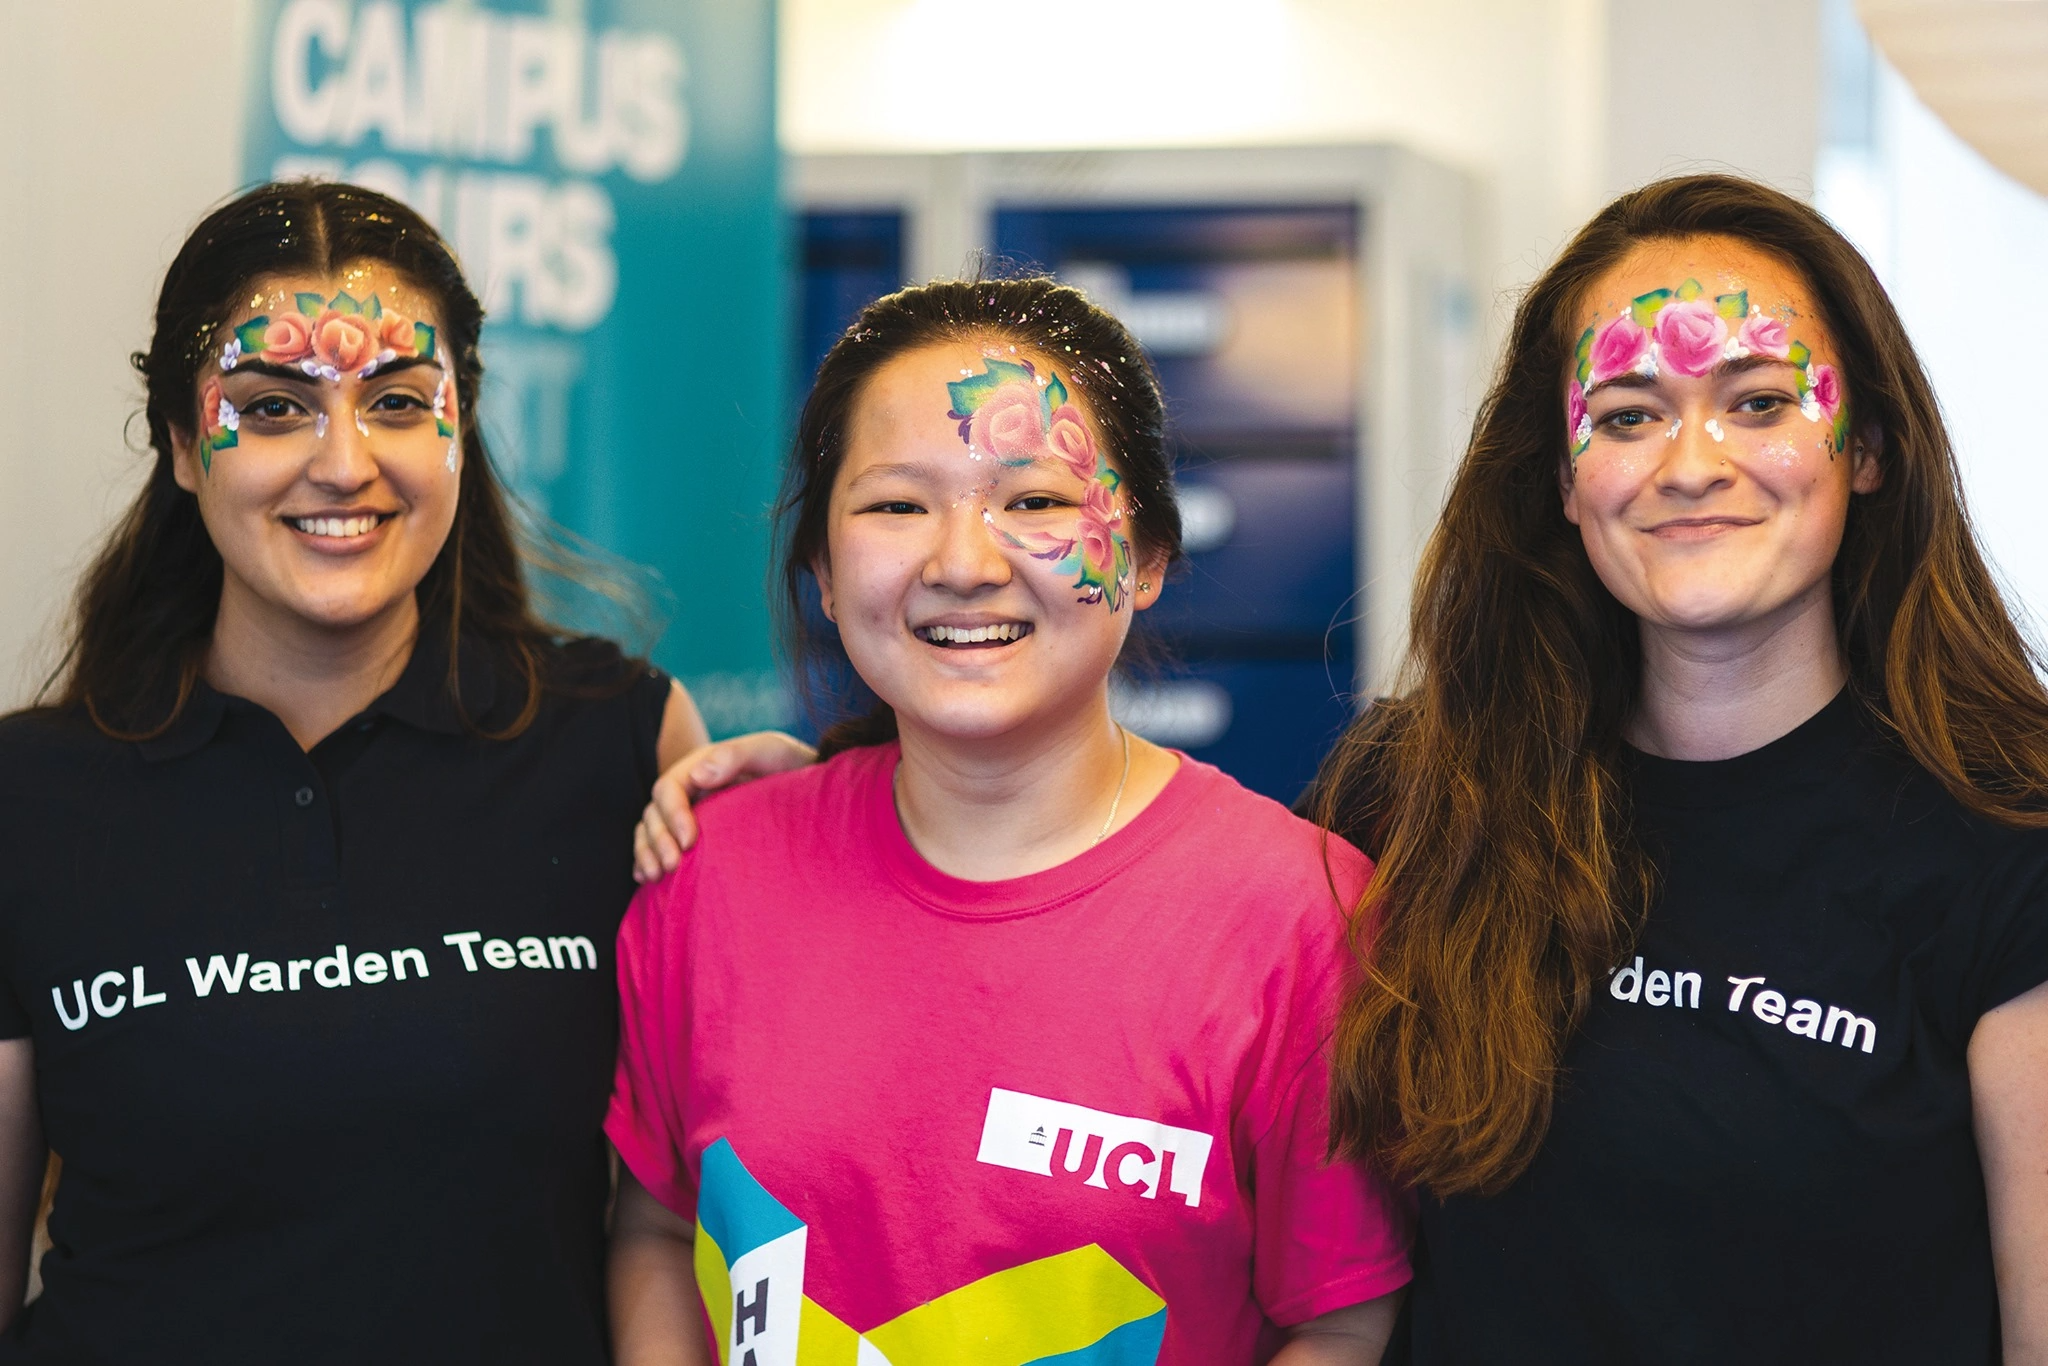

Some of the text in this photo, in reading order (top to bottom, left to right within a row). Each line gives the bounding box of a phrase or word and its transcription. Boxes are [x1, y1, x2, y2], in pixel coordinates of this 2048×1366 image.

[273, 0, 689, 181] CAMPUS
[271, 155, 617, 331] URS
[52, 931, 597, 1031] UCL Warden Team
[1608, 956, 1876, 1054] den Team
[1050, 1127, 1188, 1208] UCL
